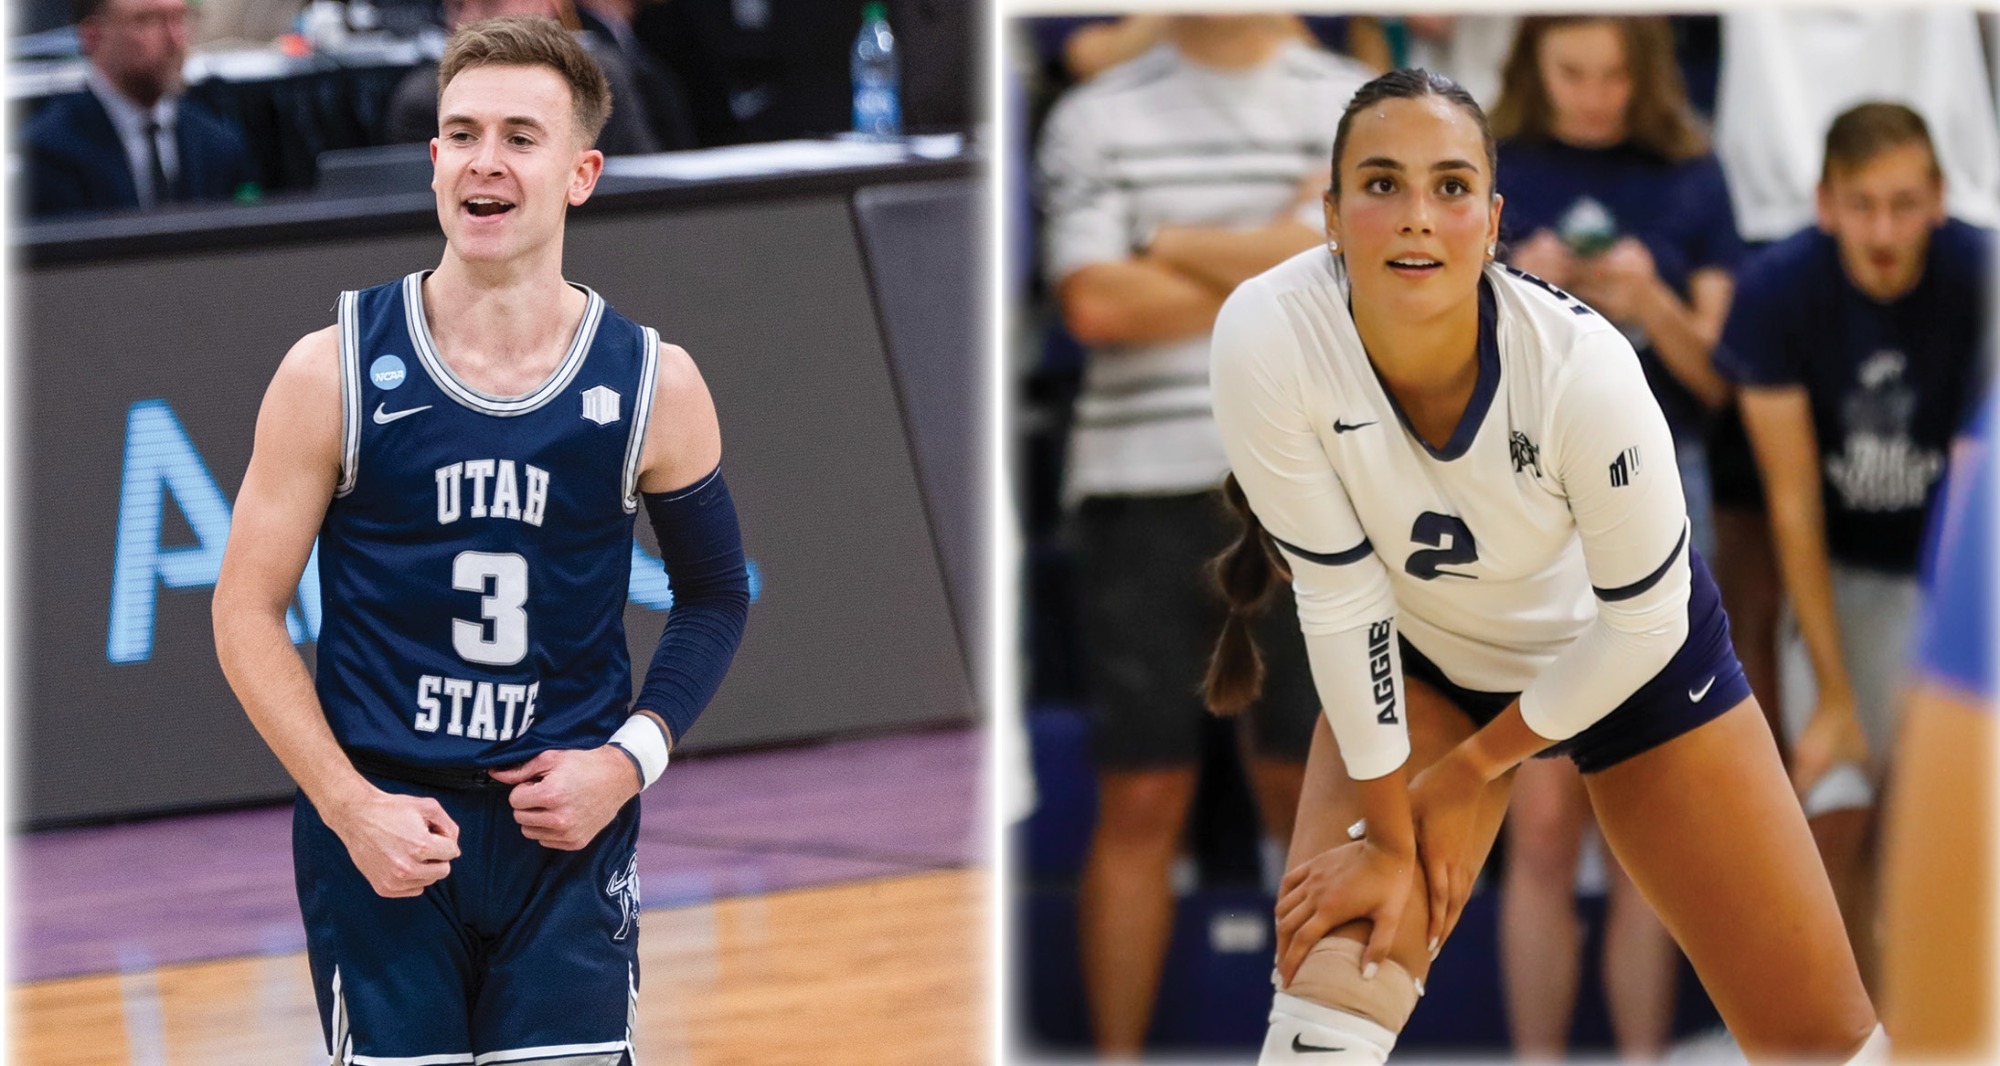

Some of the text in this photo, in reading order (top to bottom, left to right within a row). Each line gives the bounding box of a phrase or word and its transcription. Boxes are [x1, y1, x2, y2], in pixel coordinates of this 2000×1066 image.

[375, 369, 404, 382] NCAA
[435, 459, 550, 527] UTAH
[1405, 511, 1479, 581] 2
[452, 550, 529, 667] 3
[1368, 617, 1399, 725] AGGIE
[414, 674, 541, 742] STATE
